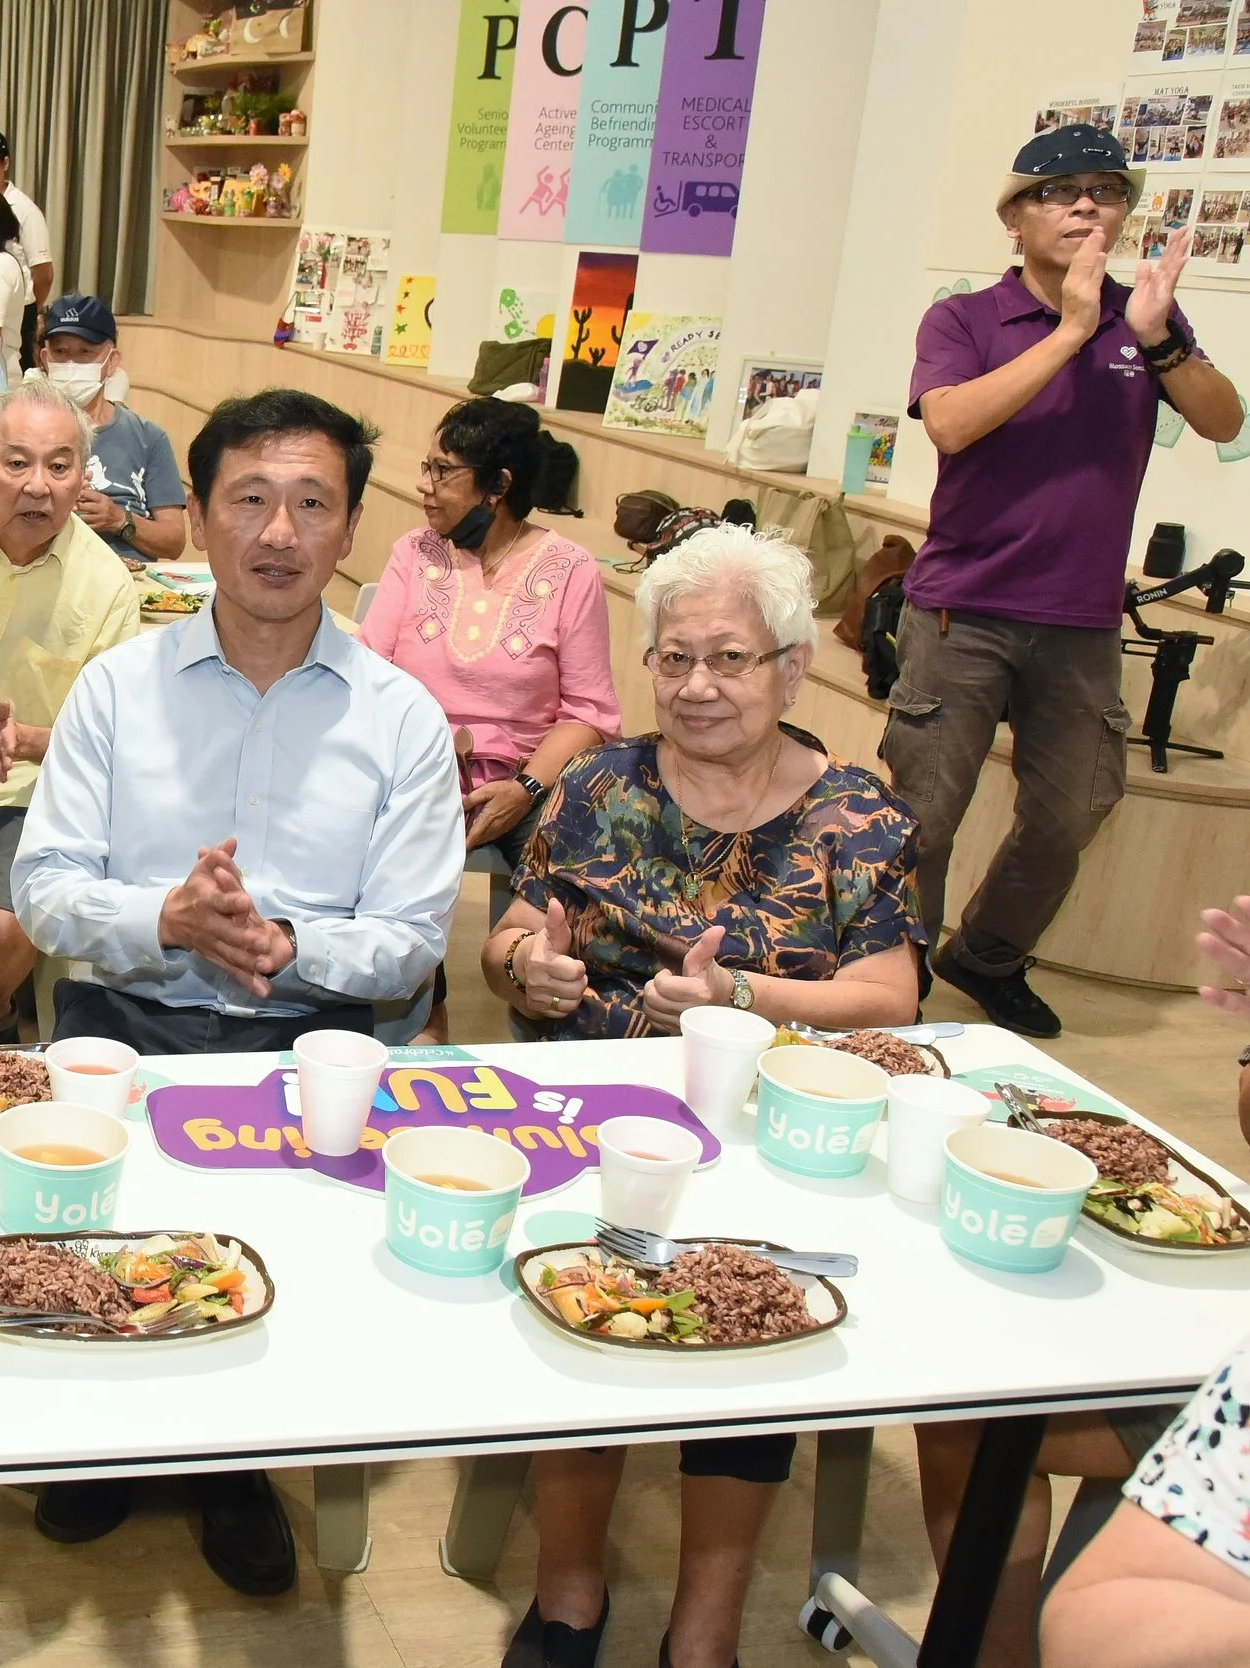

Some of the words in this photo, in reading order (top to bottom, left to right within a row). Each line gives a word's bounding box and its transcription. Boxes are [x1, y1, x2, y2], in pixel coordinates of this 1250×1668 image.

[610, 0, 669, 68] P
[591, 100, 658, 114] Communi
[681, 97, 751, 113] MEDICAL
[478, 108, 509, 120] Senio
[539, 106, 577, 120] Active
[457, 123, 507, 136] Voluntee
[683, 115, 746, 131] ESCORT
[460, 137, 507, 152] Program
[705, 134, 717, 149] &
[671, 331, 703, 352] READY
[708, 330, 722, 340] SE
[1136, 587, 1168, 604] RONIN
[532, 1090, 584, 1125] is
